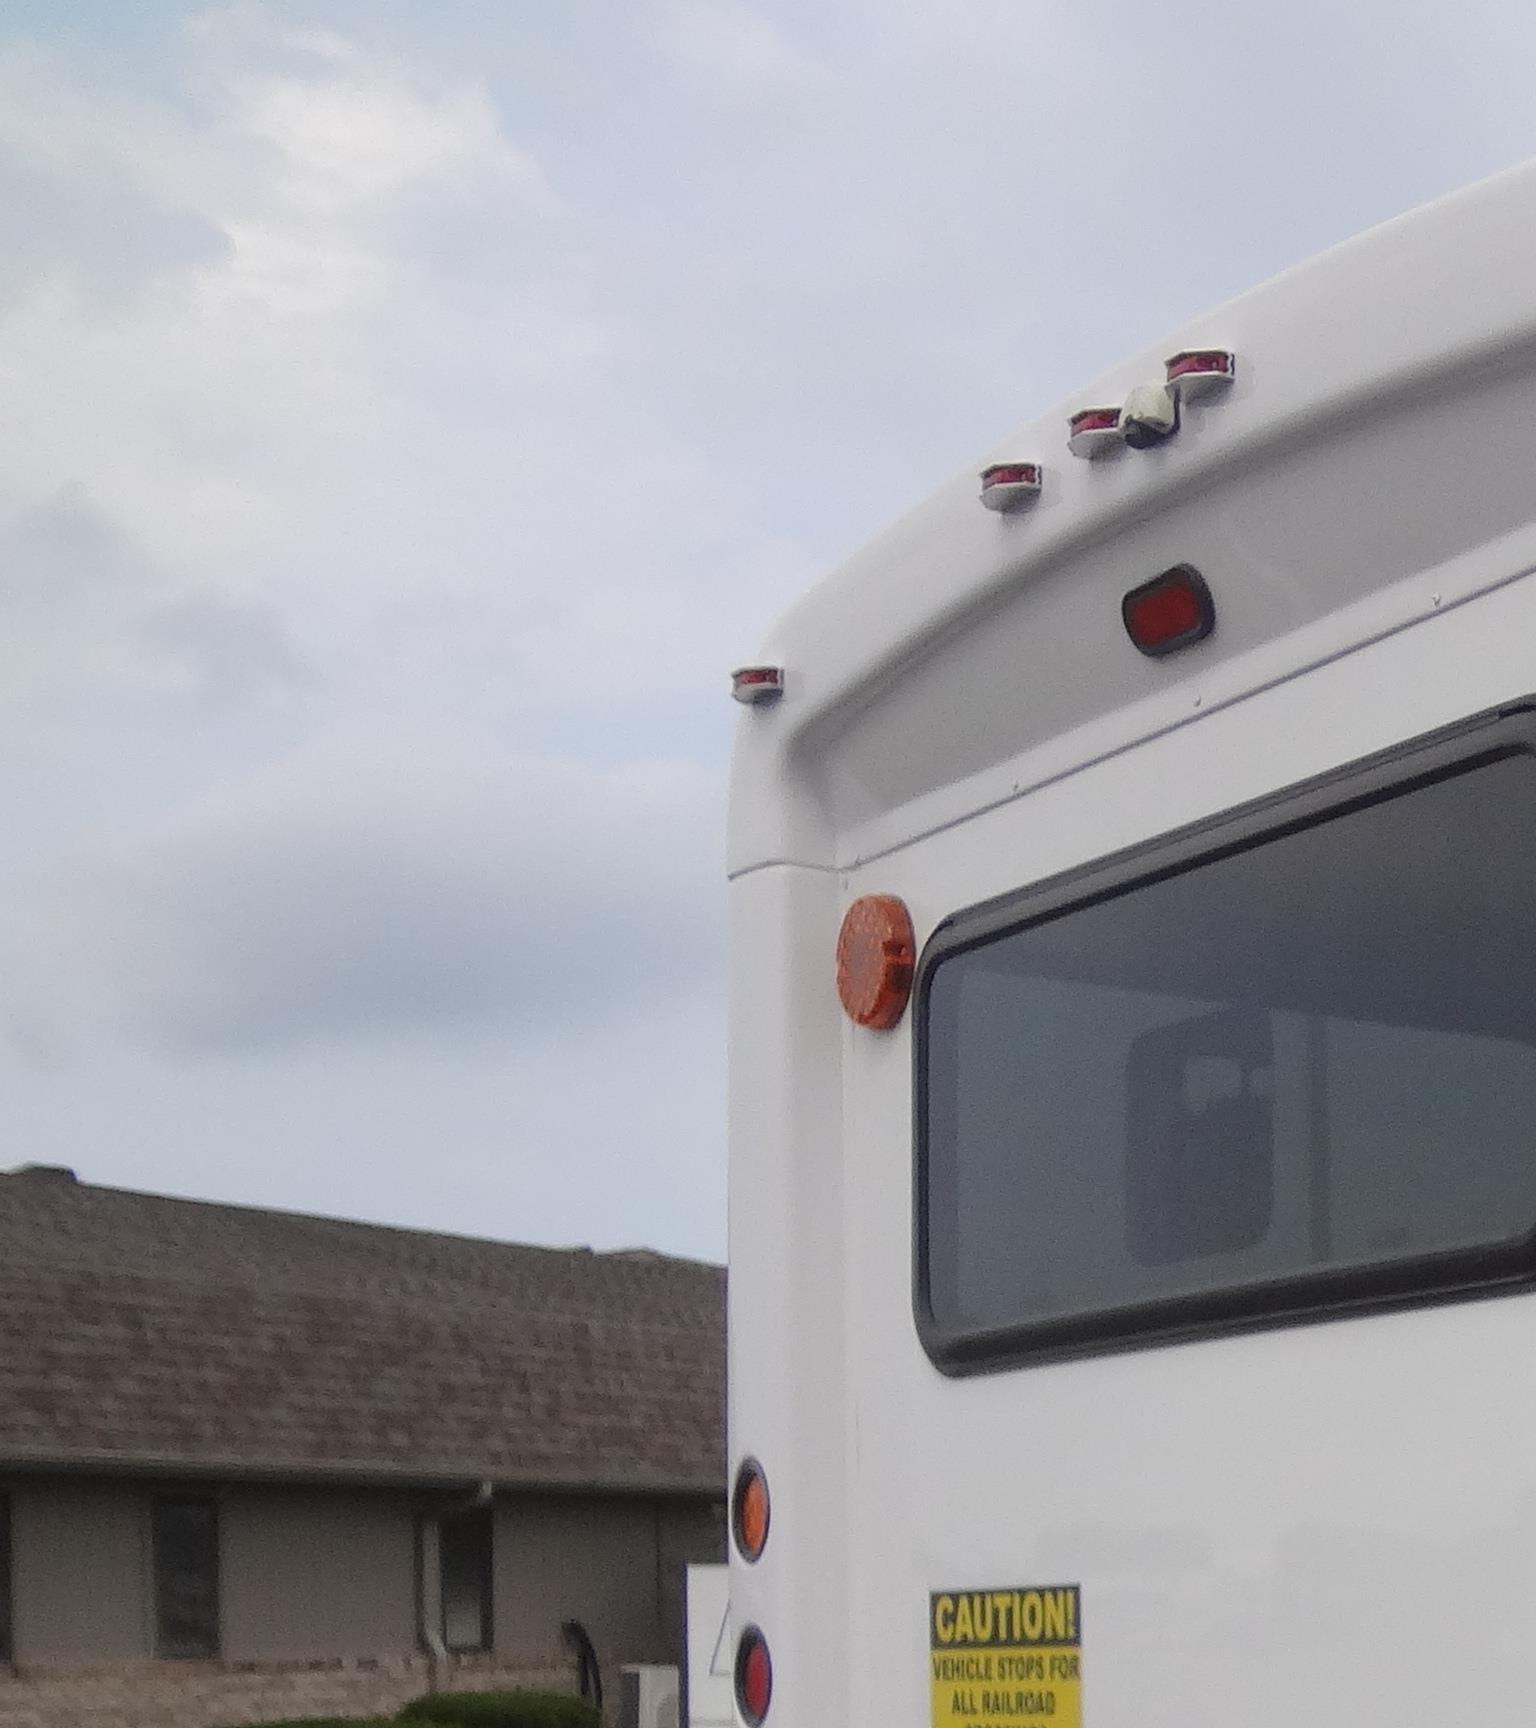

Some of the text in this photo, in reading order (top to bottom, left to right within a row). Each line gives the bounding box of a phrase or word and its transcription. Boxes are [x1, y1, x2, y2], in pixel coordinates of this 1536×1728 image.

[934, 1588, 1076, 1643] CAUTION!
[932, 1655, 1081, 1681] VEHICLE STOPS FOR
[951, 1689, 1057, 1716] ALL RAILROAD
